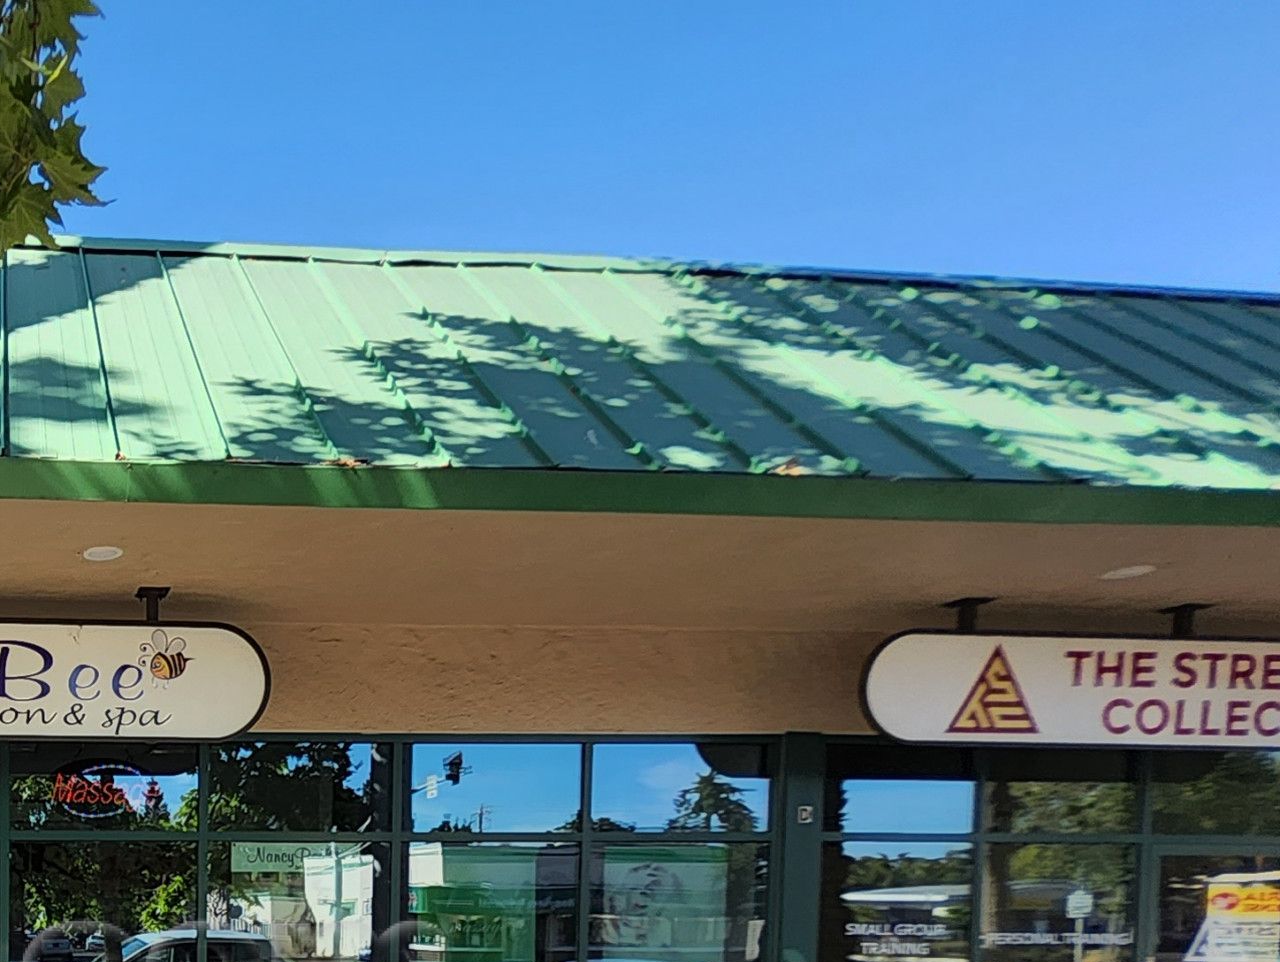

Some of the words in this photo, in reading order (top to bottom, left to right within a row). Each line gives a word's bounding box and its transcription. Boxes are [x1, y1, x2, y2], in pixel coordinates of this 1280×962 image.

[1064, 651, 1158, 688] THE
[1171, 651, 1280, 690] STRE
[63, 702, 86, 726] &
[101, 705, 173, 735] spa
[1101, 698, 1280, 738] COLLEC
[247, 848, 296, 868] Nancy
[844, 922, 894, 936] SMALL
[860, 942, 931, 956] TRAINING
